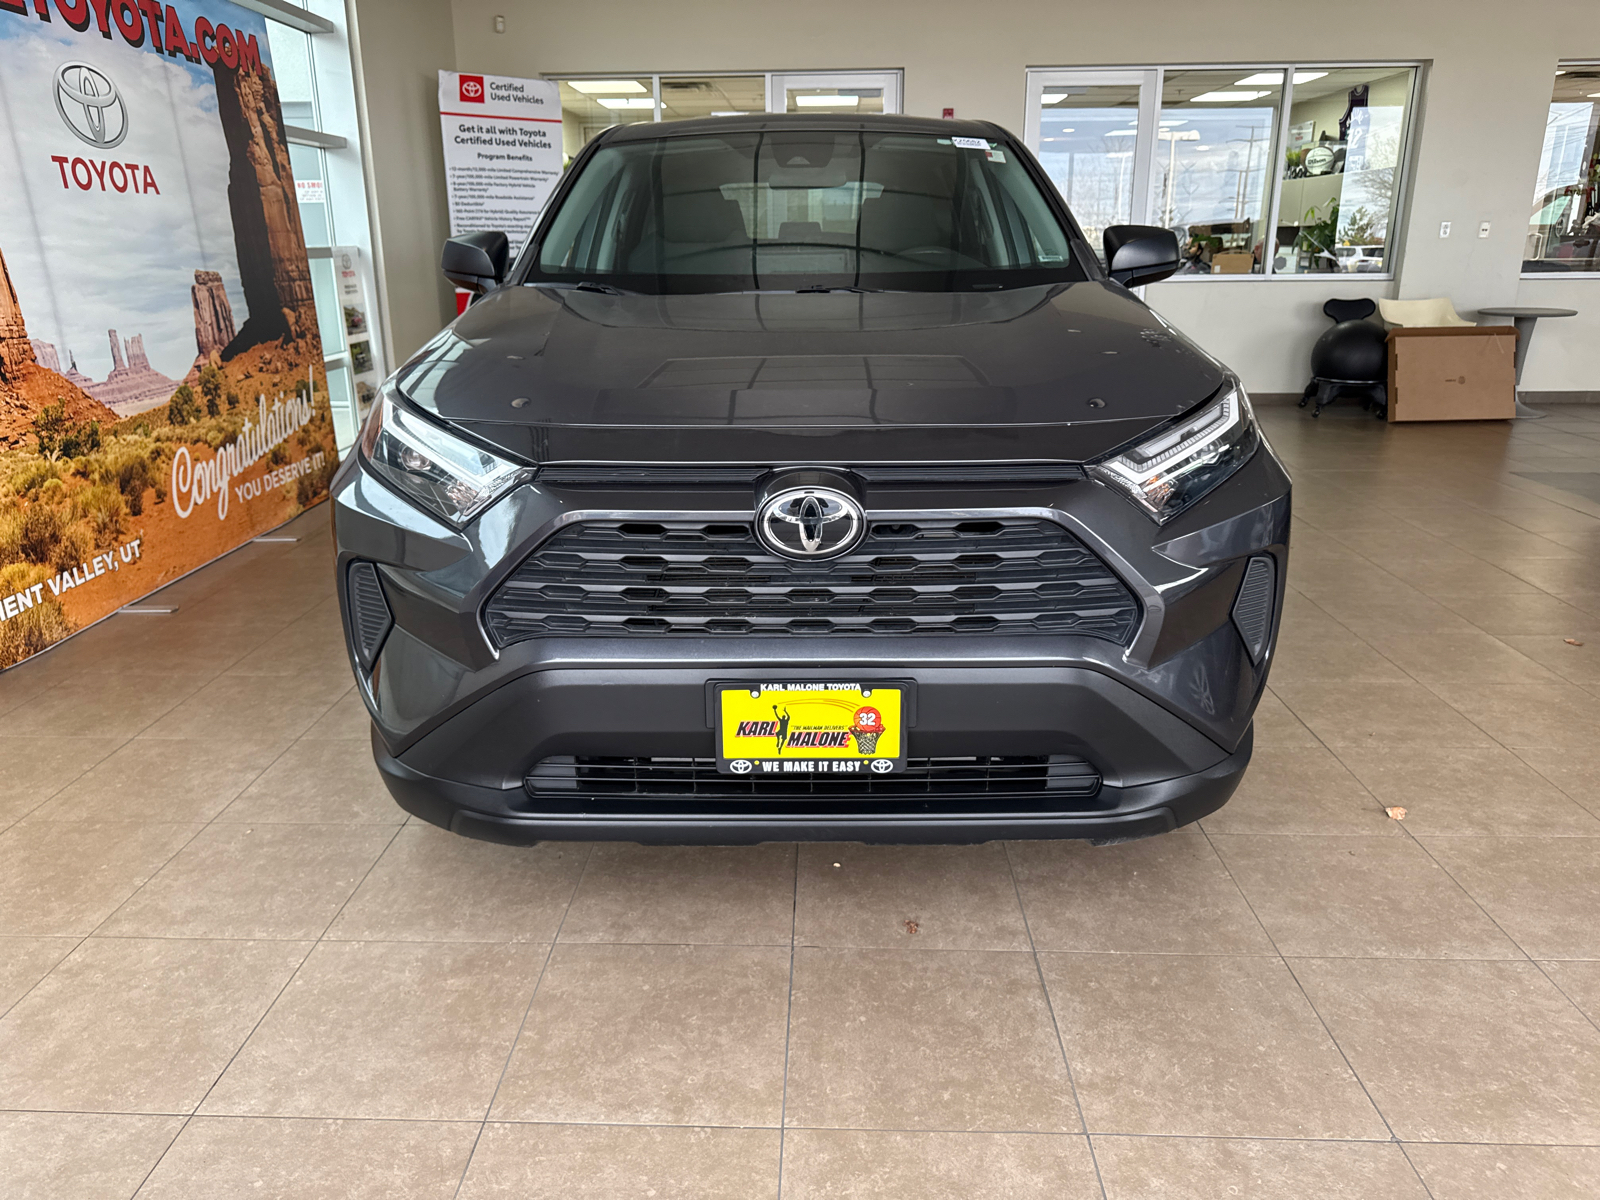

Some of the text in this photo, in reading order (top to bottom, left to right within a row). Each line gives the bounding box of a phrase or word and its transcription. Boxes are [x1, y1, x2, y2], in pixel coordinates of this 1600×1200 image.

[490, 82, 524, 92] Certified
[490, 93, 544, 105] Used Vehicles
[459, 124, 546, 138] Get it all with Toyota
[454, 136, 552, 149] Certified Used Vehicles
[477, 152, 533, 162] Program Benefits
[51, 155, 161, 195] TOYOTA
[172, 364, 316, 521] Congratulations!
[235, 451, 326, 503] YOU DESERVE IT!
[47, 551, 119, 596] VALLEY,
[120, 539, 140, 563] UT
[760, 683, 861, 691] KARL MALONE TOYOTA
[859, 713, 876, 726] 32
[736, 721, 778, 738] KARL
[786, 731, 850, 748] MALONE
[762, 761, 861, 772] WE MAKE IT EASY
